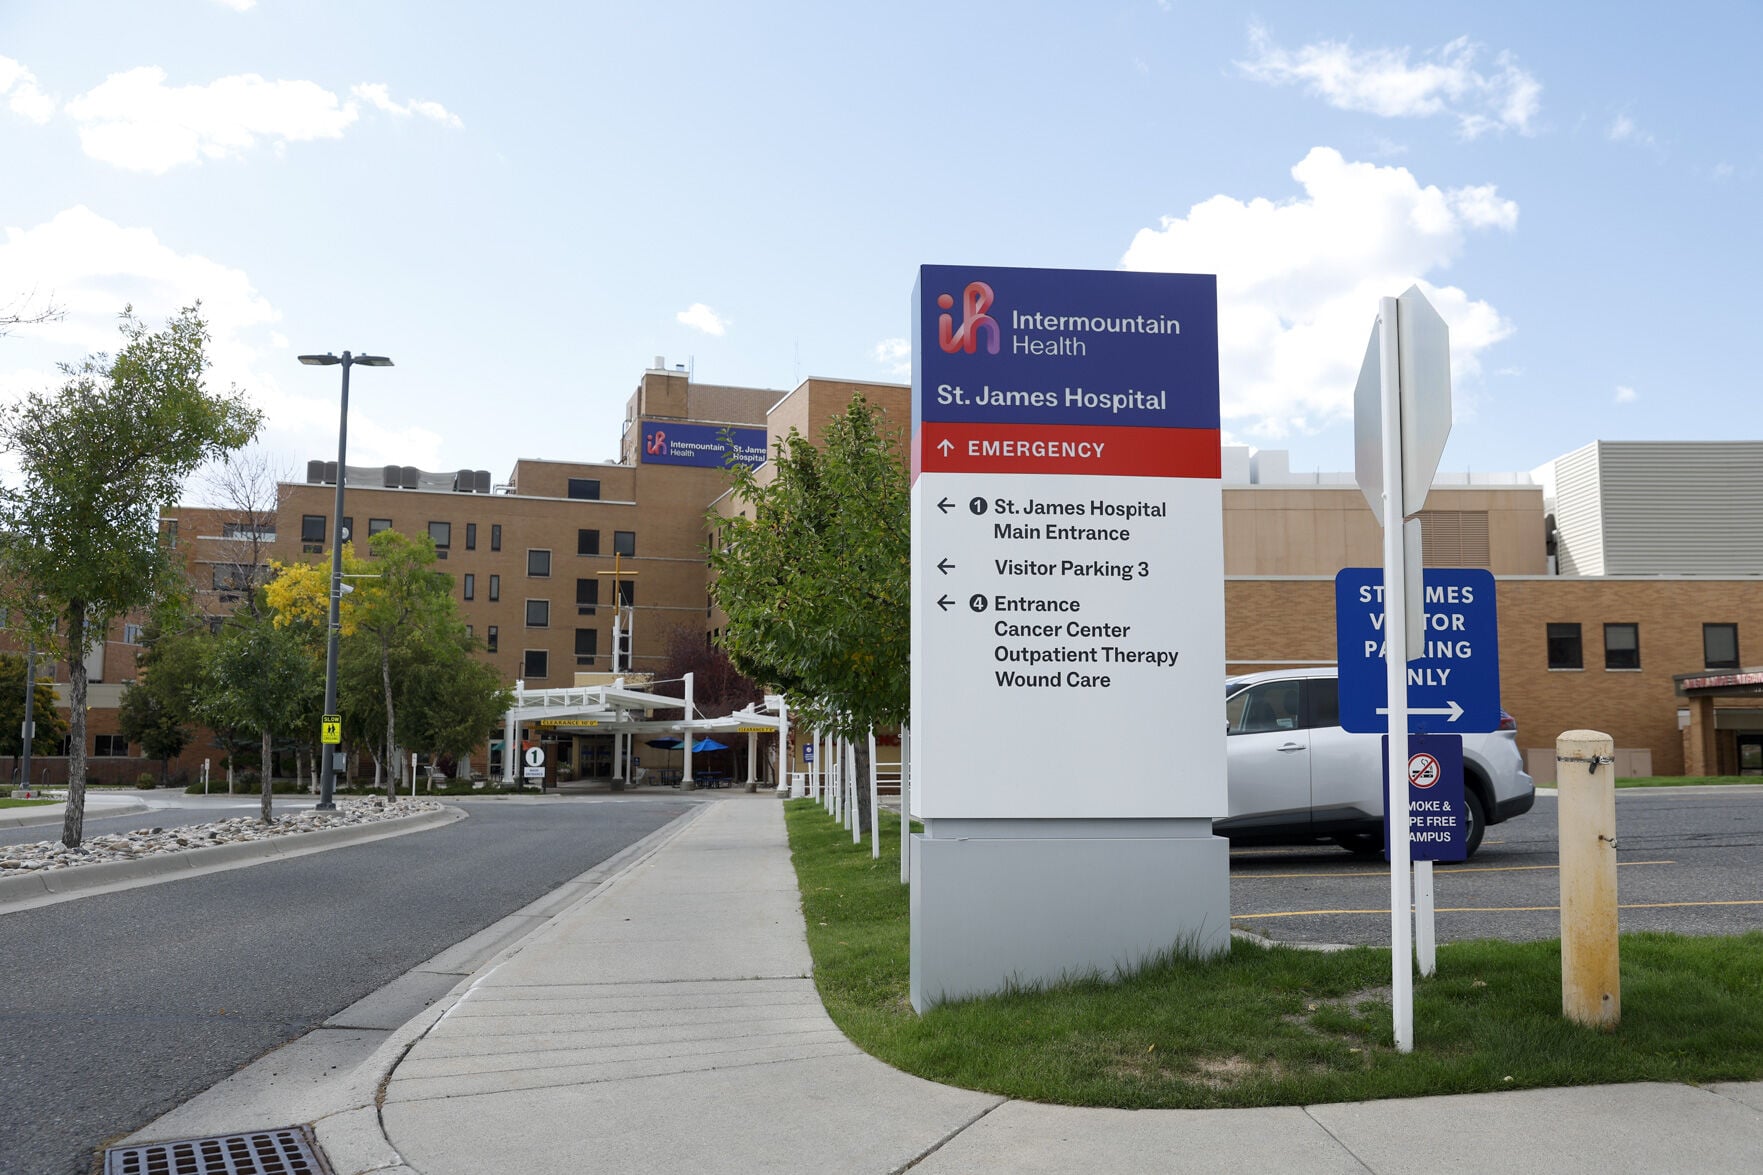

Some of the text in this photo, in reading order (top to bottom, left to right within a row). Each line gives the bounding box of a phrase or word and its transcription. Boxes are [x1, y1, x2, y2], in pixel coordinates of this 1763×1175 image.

[1012, 310, 1181, 335] Intermountain
[1013, 334, 1086, 356] Health
[937, 384, 1166, 413] St. James Hospital
[670, 440, 725, 452] Intermountain
[670, 449, 695, 457] Health
[745, 445, 767, 454] Jame
[968, 440, 1105, 458] EMERGENCY
[733, 453, 765, 463] Hospital
[994, 498, 1020, 515] St.
[1023, 499, 1085, 516] James
[1090, 500, 1167, 521] Hospital
[994, 523, 1130, 541] Main Entrance
[995, 559, 1150, 581] Visitor Parking 3
[1426, 586, 1474, 604] MES
[995, 596, 1081, 612] Entrance
[994, 621, 1131, 638] Cancer Center
[994, 646, 1179, 667] Outpatient Therapy
[995, 671, 1111, 688] Wound Care
[1408, 668, 1451, 686] NLY
[531, 750, 538, 764] 1
[1408, 801, 1452, 811] MOKE &
[1409, 817, 1457, 827] PE FREE
[1409, 832, 1451, 842] AMPUS
